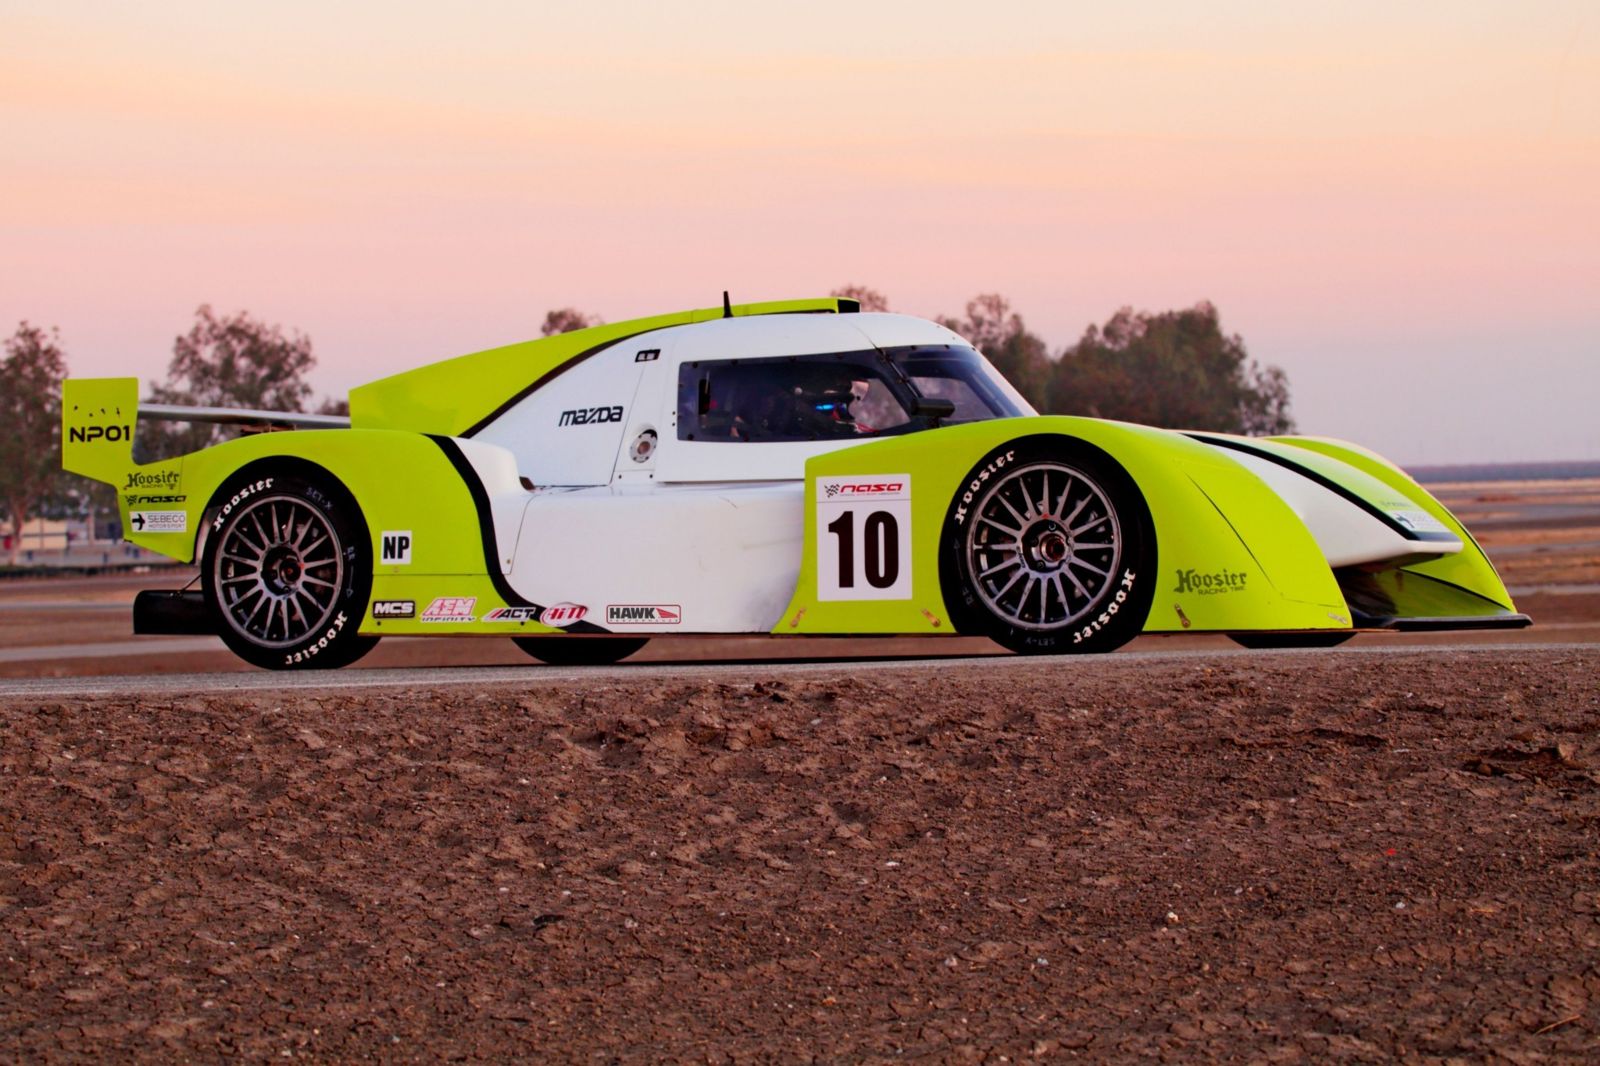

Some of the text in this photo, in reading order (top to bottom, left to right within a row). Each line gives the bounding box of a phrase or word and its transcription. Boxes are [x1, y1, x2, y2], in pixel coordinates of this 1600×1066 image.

[558, 405, 624, 427] mazda
[69, 425, 131, 443] NP01
[123, 470, 180, 490] Hoosier
[954, 450, 1015, 525] Hoosier
[213, 477, 275, 532] Hoosier
[147, 514, 186, 524] SEBECO
[383, 536, 410, 559] NP
[828, 510, 899, 589] 10
[1173, 568, 1247, 593] Hoosier
[1198, 587, 1228, 595] RACING
[374, 602, 414, 614] MCS
[422, 598, 476, 616] AEM
[497, 608, 535, 618] ACT
[609, 607, 655, 619] HAWK
[1073, 568, 1137, 644] Hoosier
[285, 610, 348, 665] Hoosier
